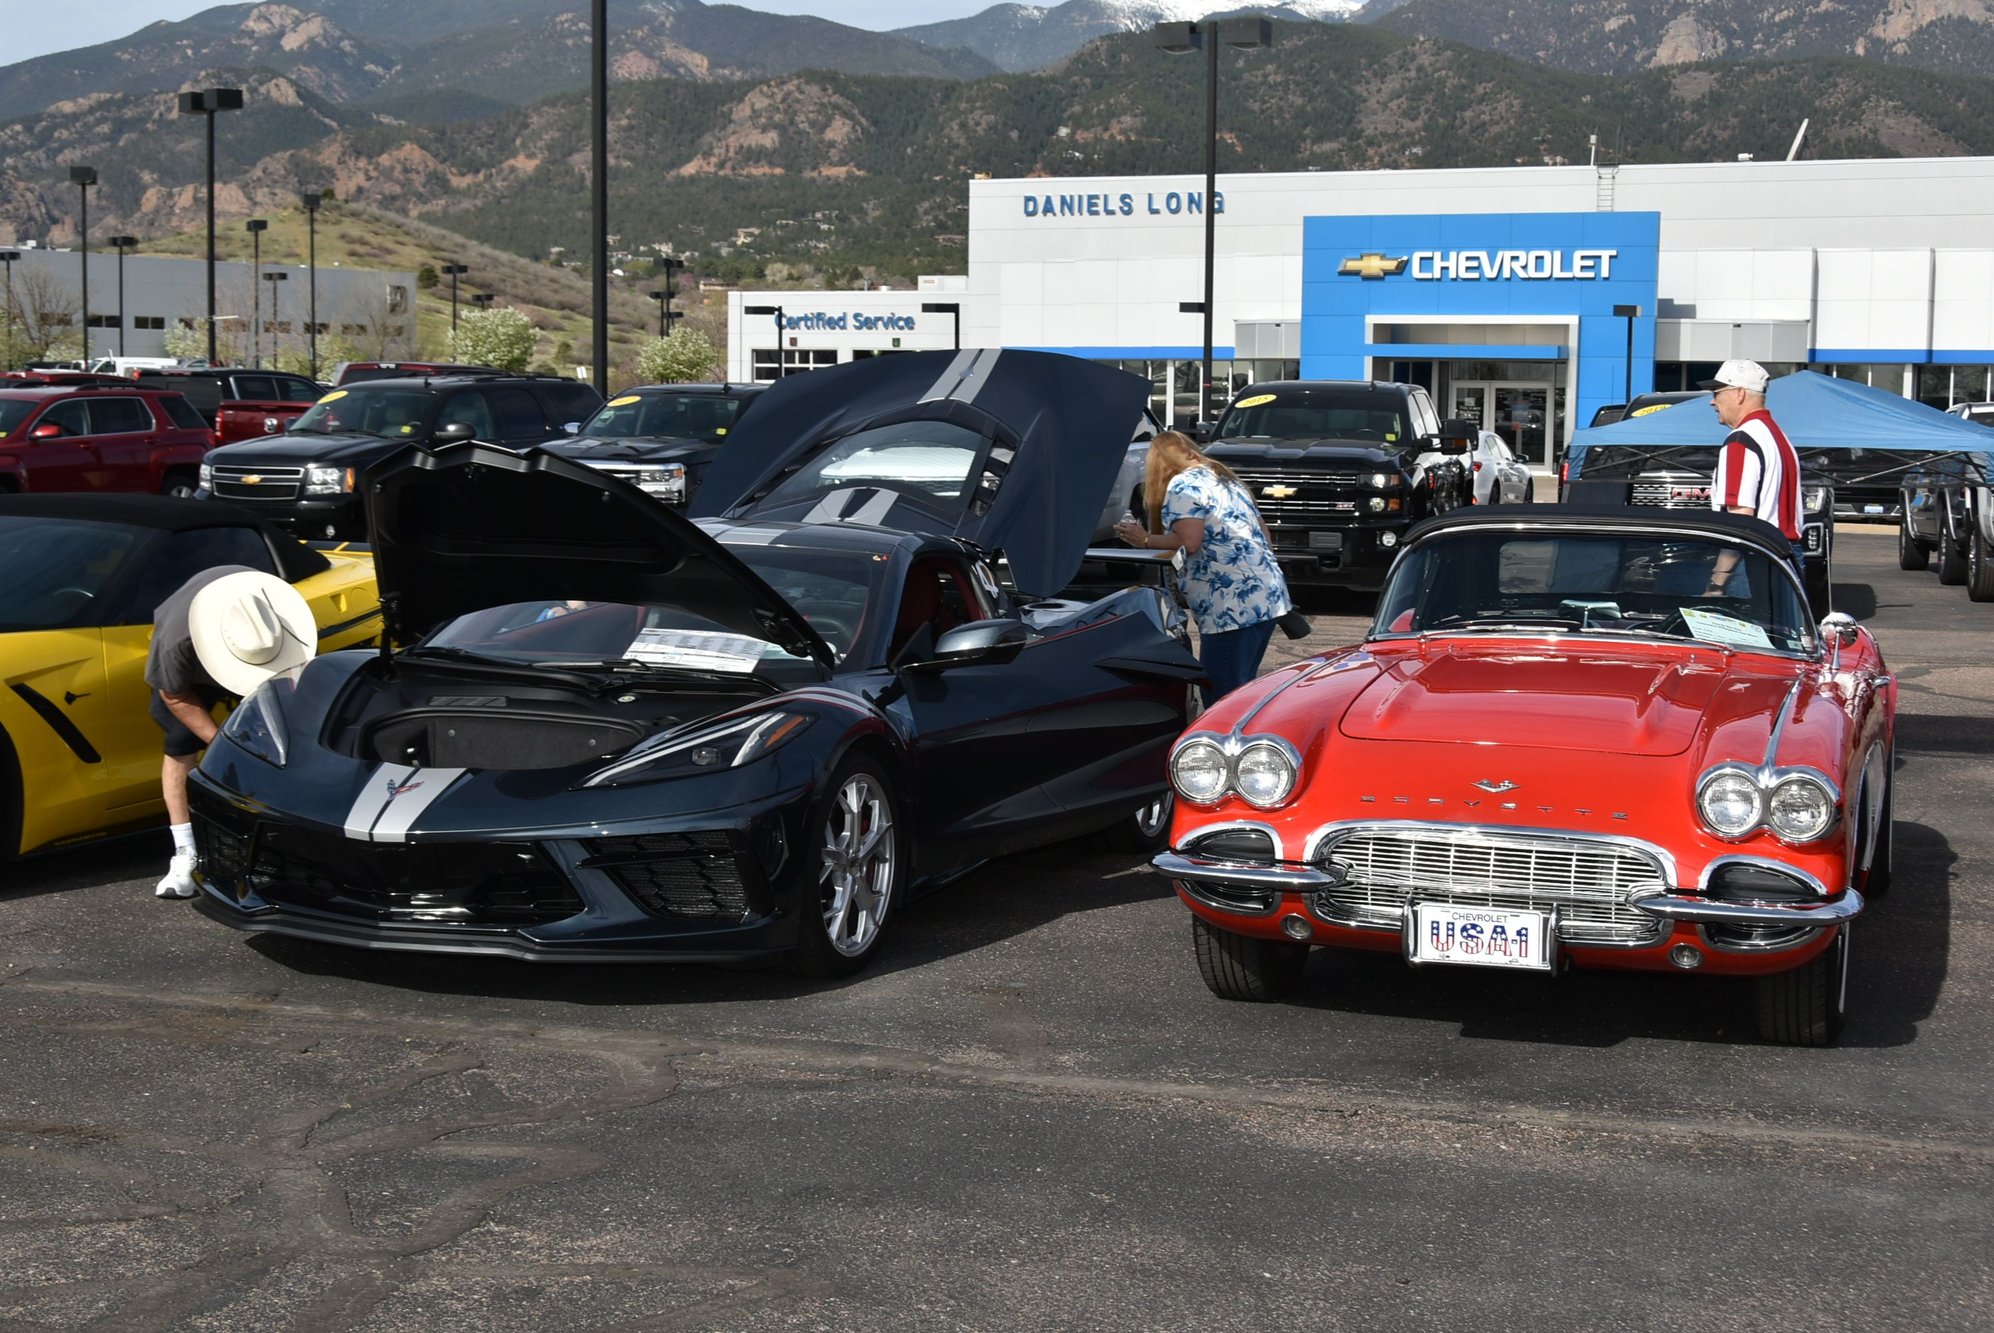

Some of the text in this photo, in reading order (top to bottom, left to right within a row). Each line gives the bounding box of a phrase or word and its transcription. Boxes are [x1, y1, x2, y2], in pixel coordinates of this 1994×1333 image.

[1024, 191, 1225, 217] DANIELS LONG
[1411, 250, 1617, 280] CHEVROLET
[775, 312, 916, 331] Certified Service
[1671, 487, 1712, 500] GM
[1452, 911, 1509, 923] CHEVROLET
[1430, 920, 1529, 958] USA-1
